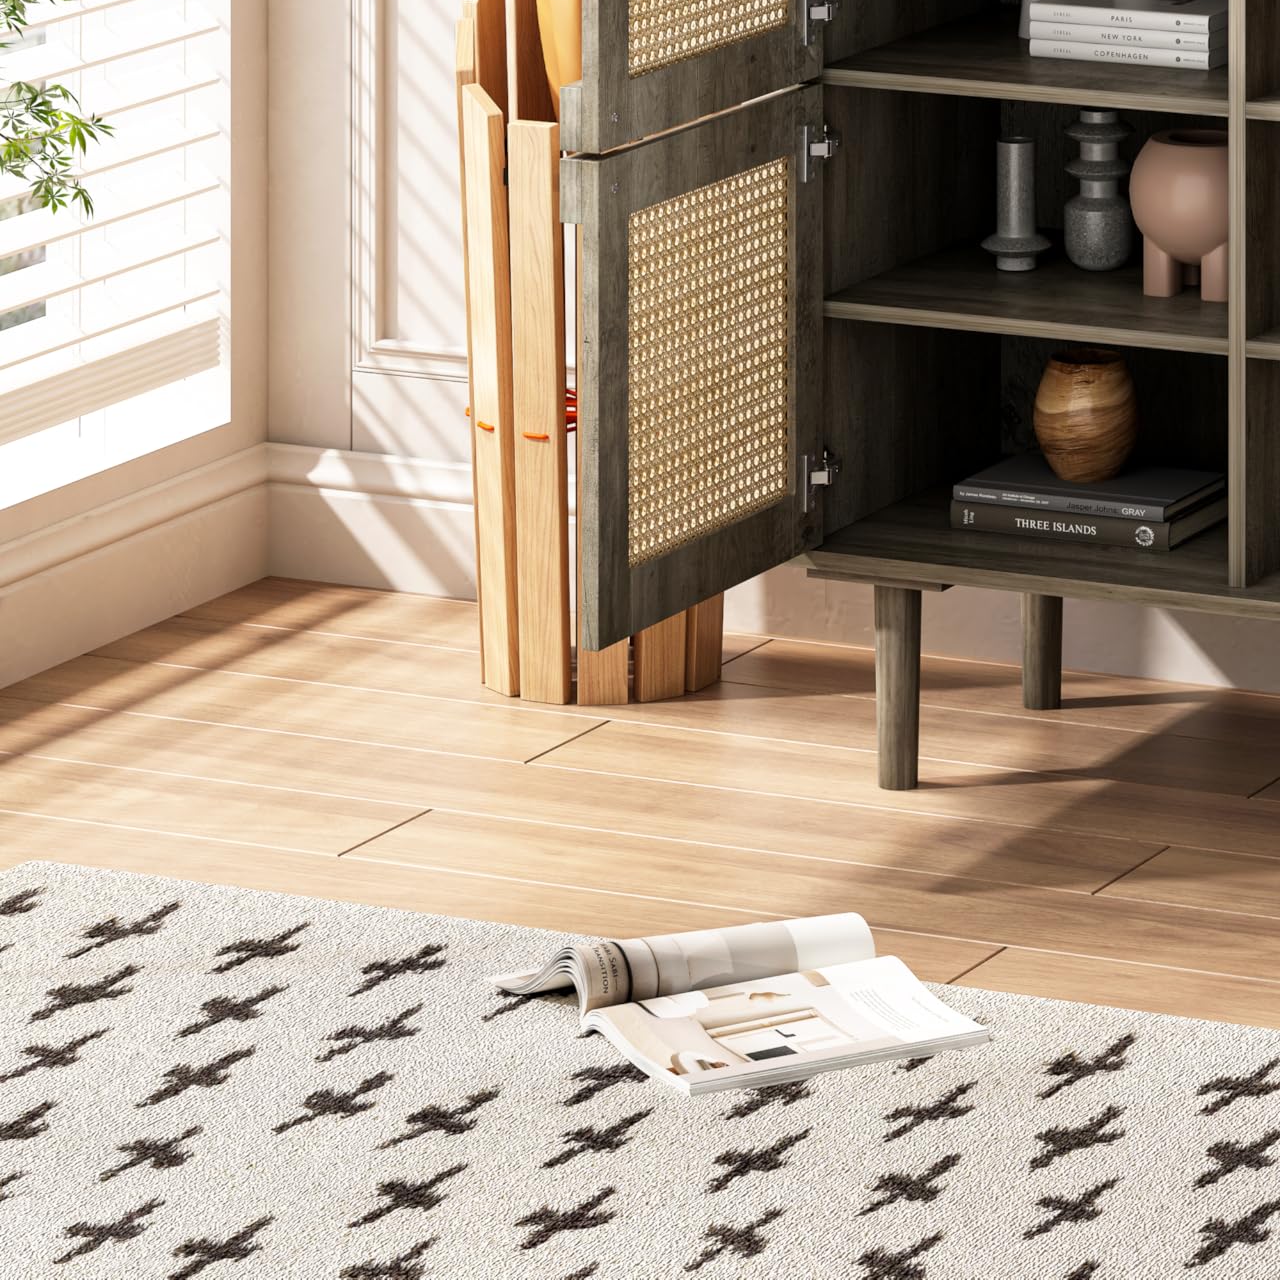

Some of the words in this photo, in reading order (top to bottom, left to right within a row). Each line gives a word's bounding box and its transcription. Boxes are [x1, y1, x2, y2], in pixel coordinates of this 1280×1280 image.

[1111, 15, 1133, 23] PARIS
[1122, 34, 1143, 42] YORK
[1094, 50, 1149, 61] COPENHAGEN
[1121, 507, 1146, 517] GRAY
[1015, 518, 1051, 531] THREE
[1053, 521, 1097, 536] ISLANDS
